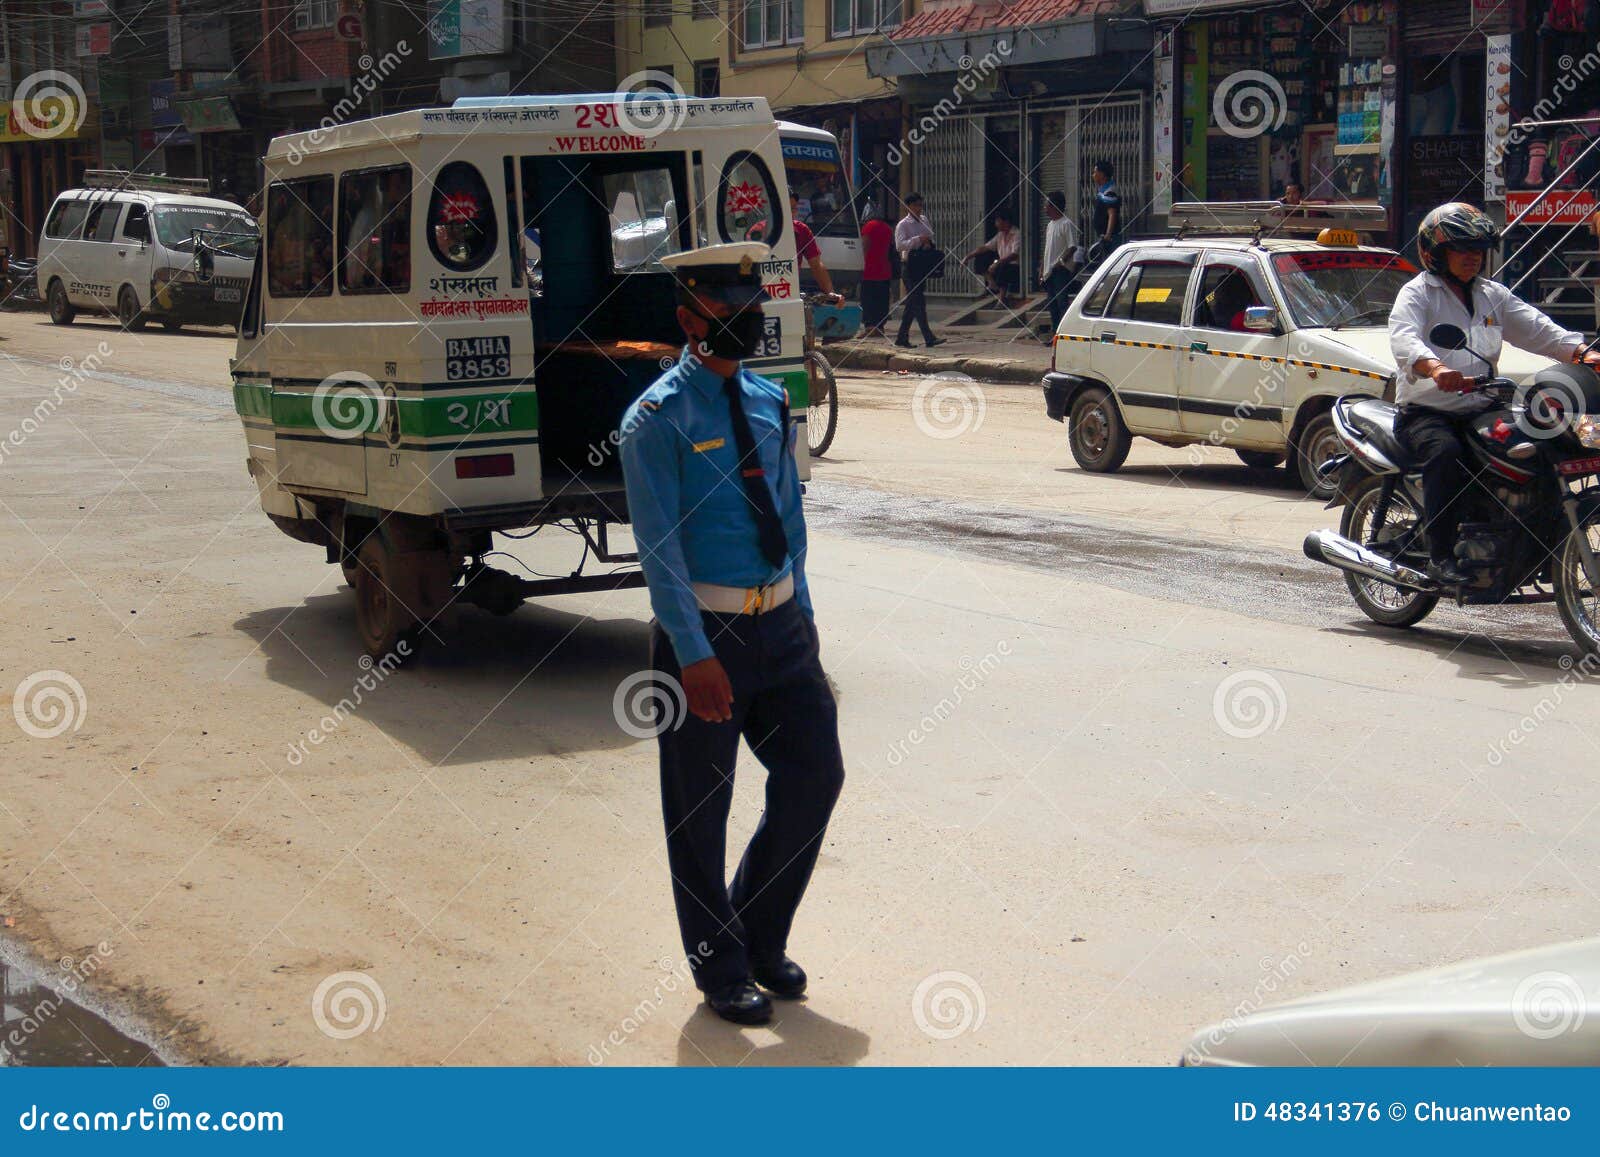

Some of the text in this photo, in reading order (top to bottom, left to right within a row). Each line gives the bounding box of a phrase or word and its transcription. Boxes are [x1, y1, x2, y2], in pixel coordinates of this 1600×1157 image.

[556, 135, 646, 153] WELCOME
[781, 145, 834, 159] तायात
[1329, 230, 1355, 244] TAXI
[447, 358, 511, 380] 3853
